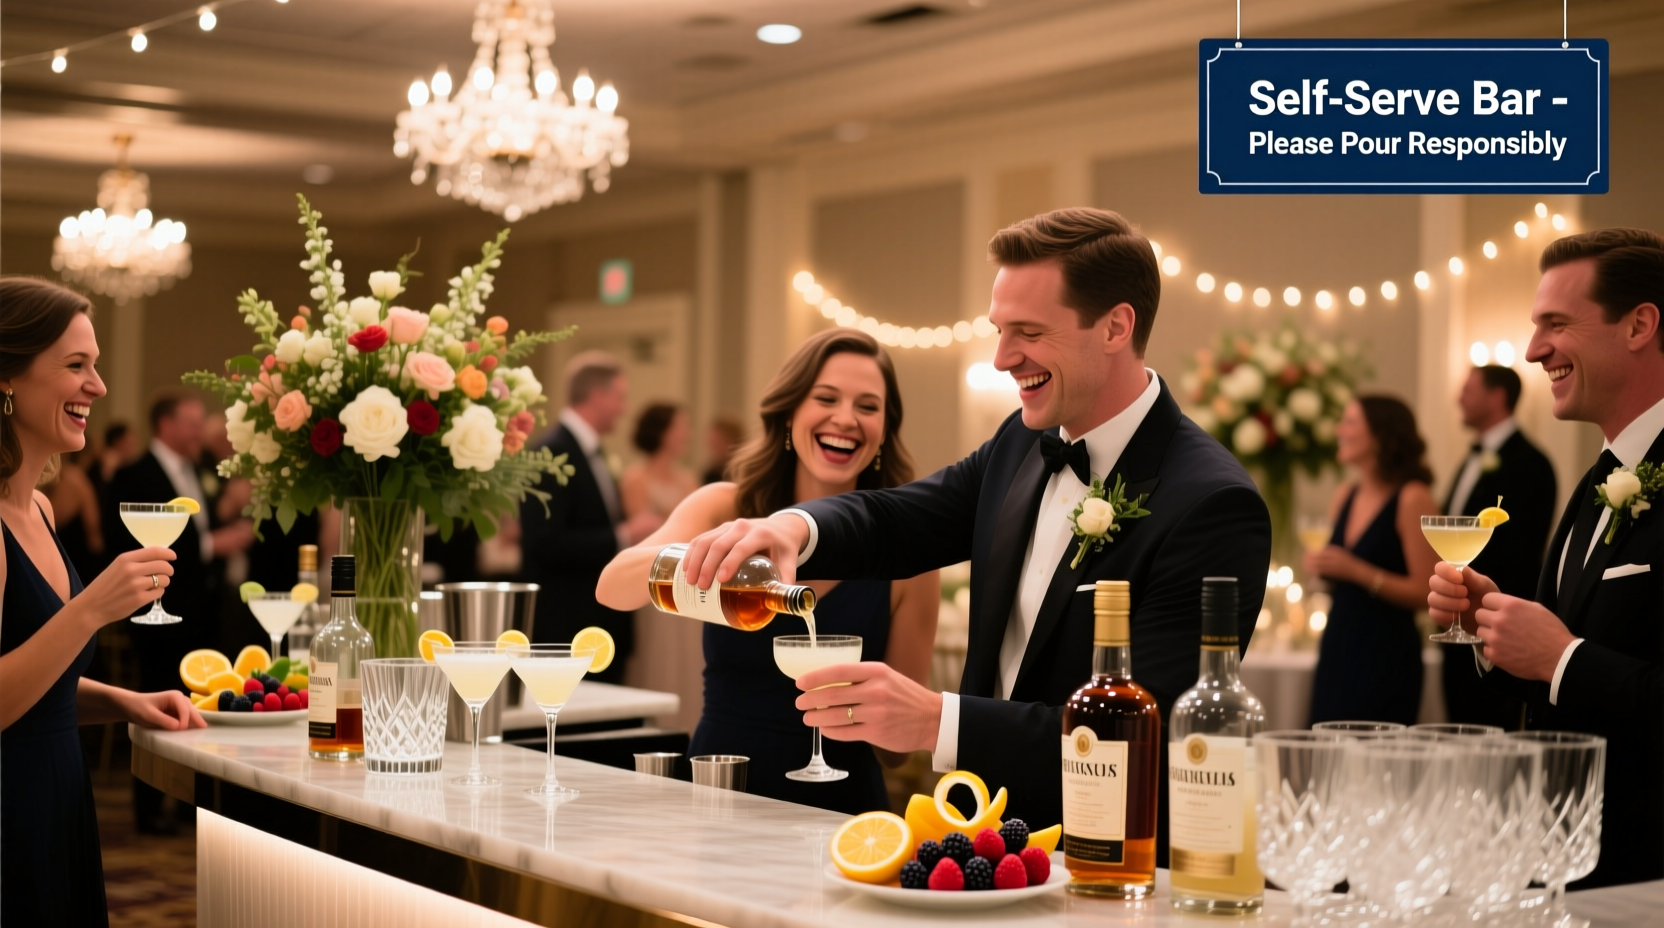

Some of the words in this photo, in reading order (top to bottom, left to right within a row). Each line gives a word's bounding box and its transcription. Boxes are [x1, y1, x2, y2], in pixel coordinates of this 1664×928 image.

[1248, 78, 1460, 116] Self-Serve
[1473, 79, 1542, 116] Bar
[1552, 97, 1568, 105] -
[1249, 130, 1334, 155] Please
[1341, 131, 1402, 155] Pour
[1408, 129, 1568, 162] Responsibly
